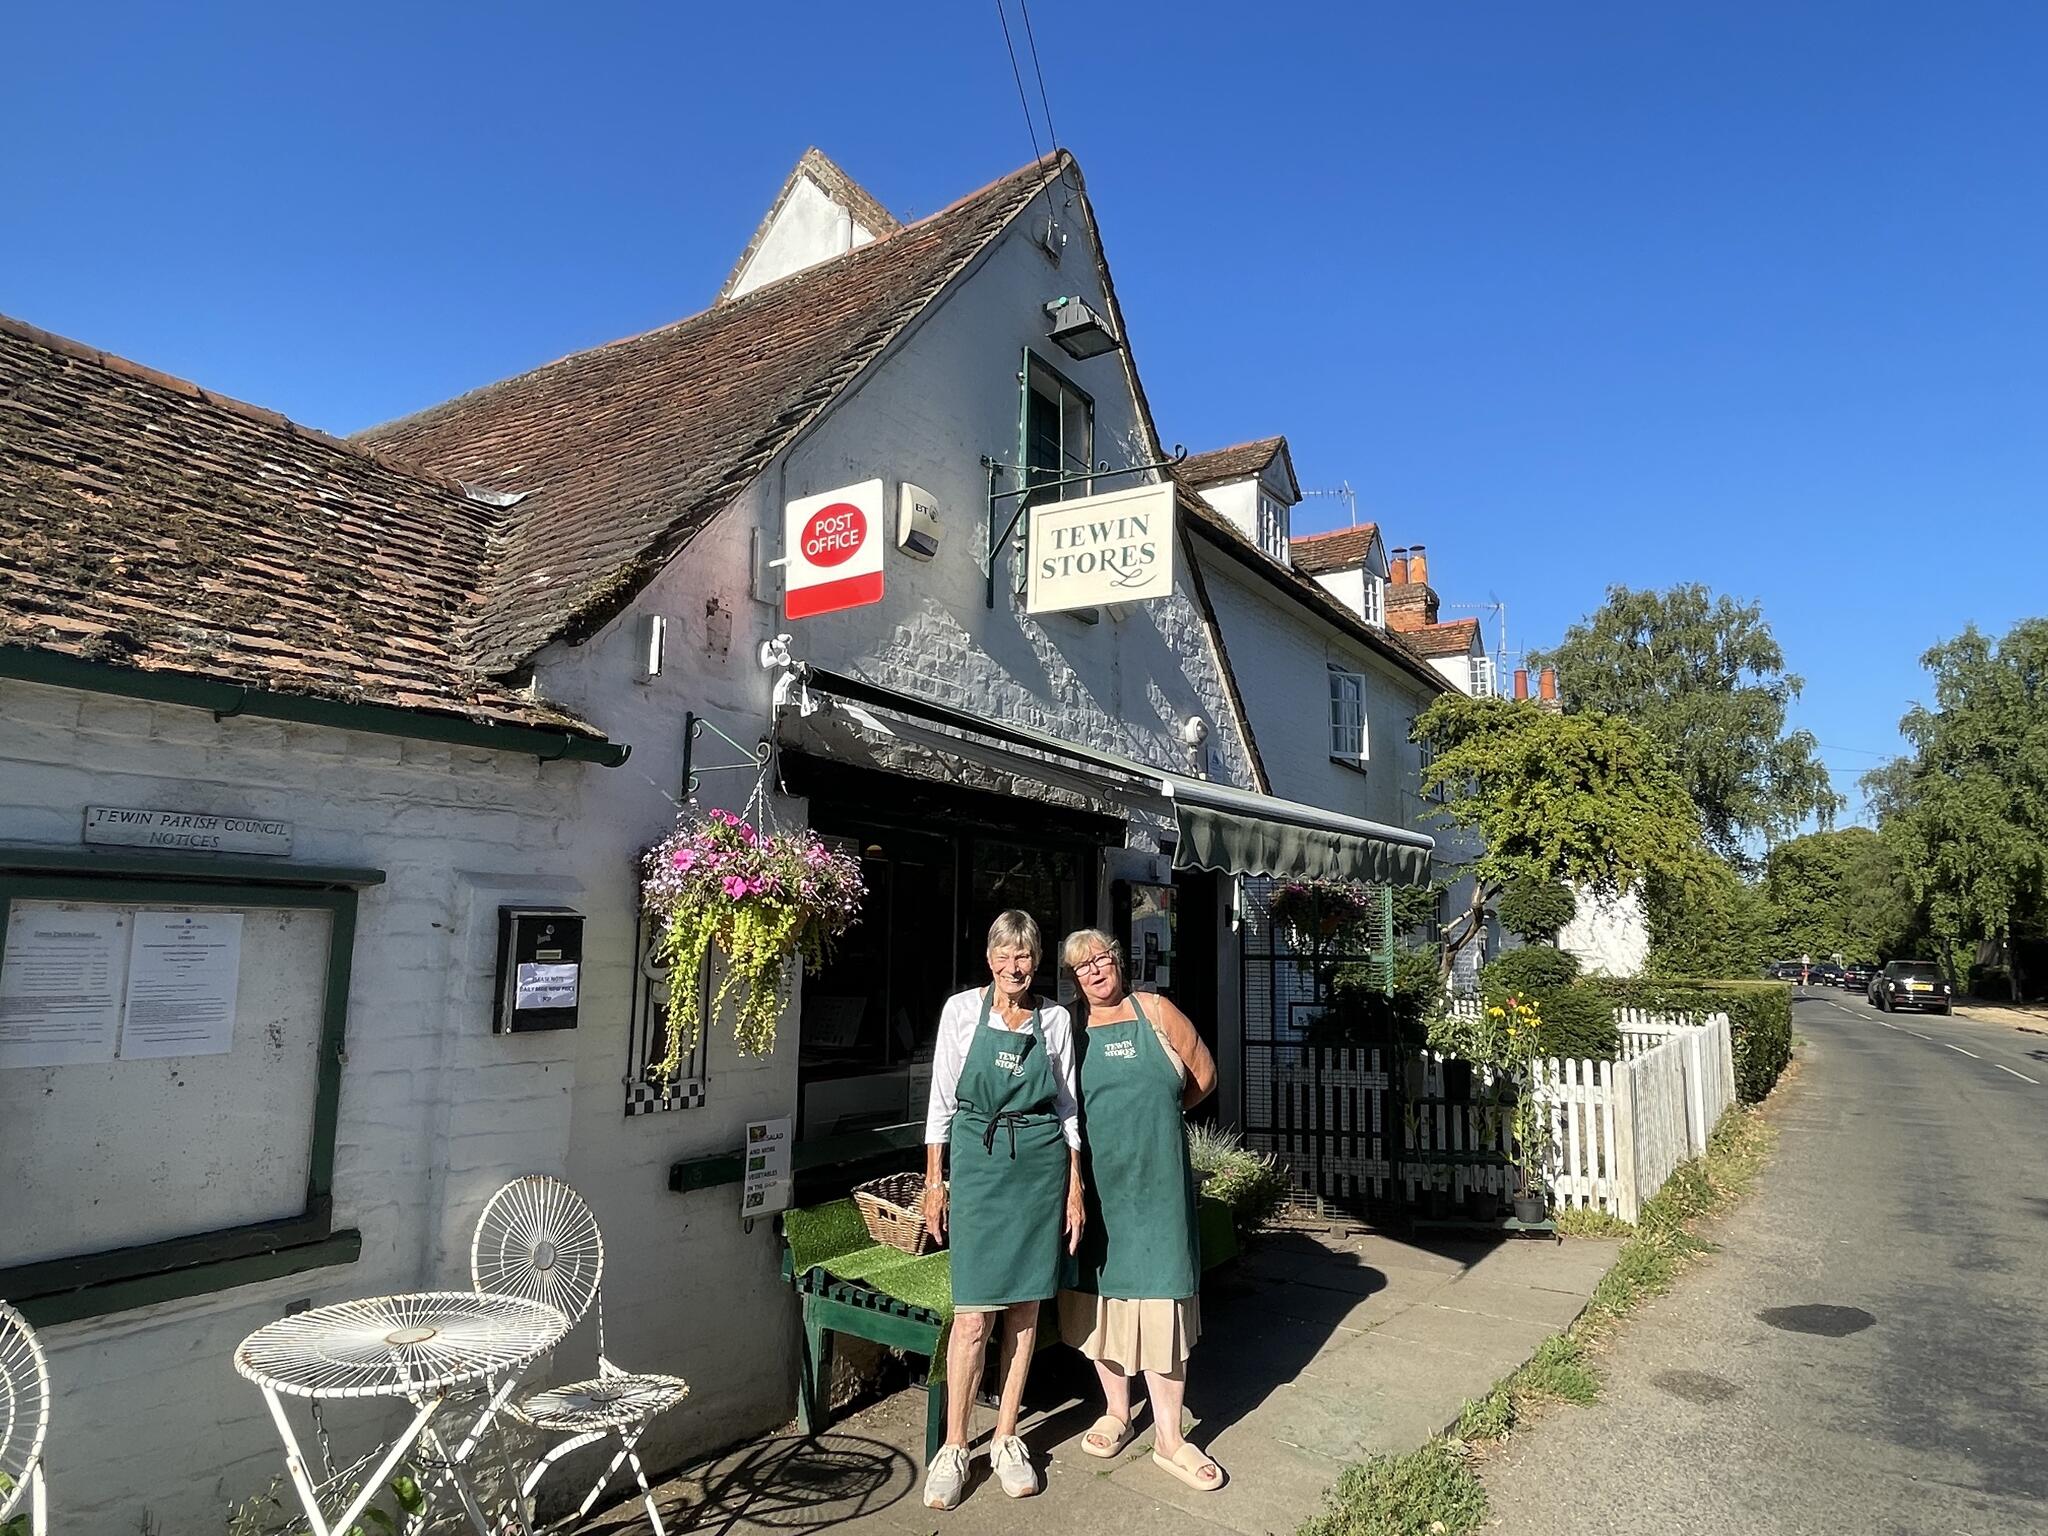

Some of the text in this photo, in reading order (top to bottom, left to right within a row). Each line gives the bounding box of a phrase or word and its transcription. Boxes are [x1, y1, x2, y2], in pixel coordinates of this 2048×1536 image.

[915, 503, 928, 515] BT
[815, 512, 853, 537] POST
[1051, 514, 1150, 550] TEWIN
[806, 529, 859, 556] OFFICE
[1041, 542, 1157, 588] STORES
[96, 809, 287, 836] TEWIN PARISH COUNCIL
[150, 832, 220, 848] NOTICES
[1104, 1040, 1132, 1051] TEWIN
[1104, 1047, 1137, 1059] STORES
